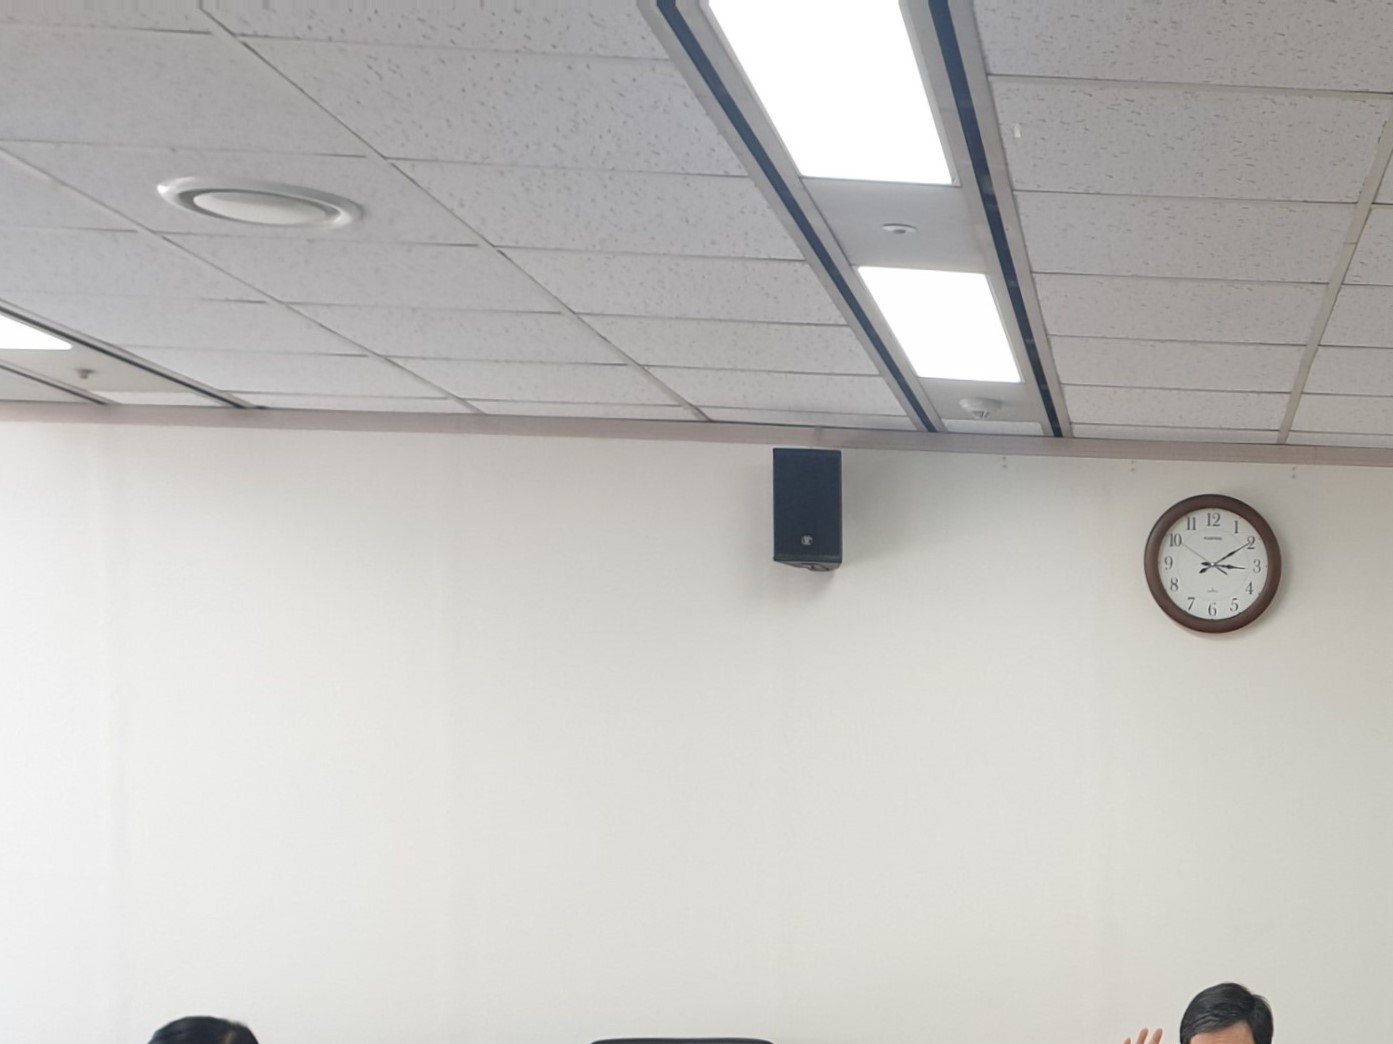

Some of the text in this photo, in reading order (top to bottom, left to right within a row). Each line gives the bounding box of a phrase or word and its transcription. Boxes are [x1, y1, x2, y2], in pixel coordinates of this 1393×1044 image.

[1186, 516, 1196, 530] 11
[1206, 513, 1220, 526] 12
[1234, 520, 1239, 534] 1
[1170, 533, 1182, 547] 10
[1246, 536, 1255, 549] 2
[1164, 556, 1173, 570] 9
[1253, 560, 1261, 573] 3
[1170, 578, 1179, 591] 8
[1245, 582, 1254, 595] 4
[1188, 597, 1195, 611] 7
[1208, 603, 1217, 616] 6
[1230, 598, 1239, 612] 5
